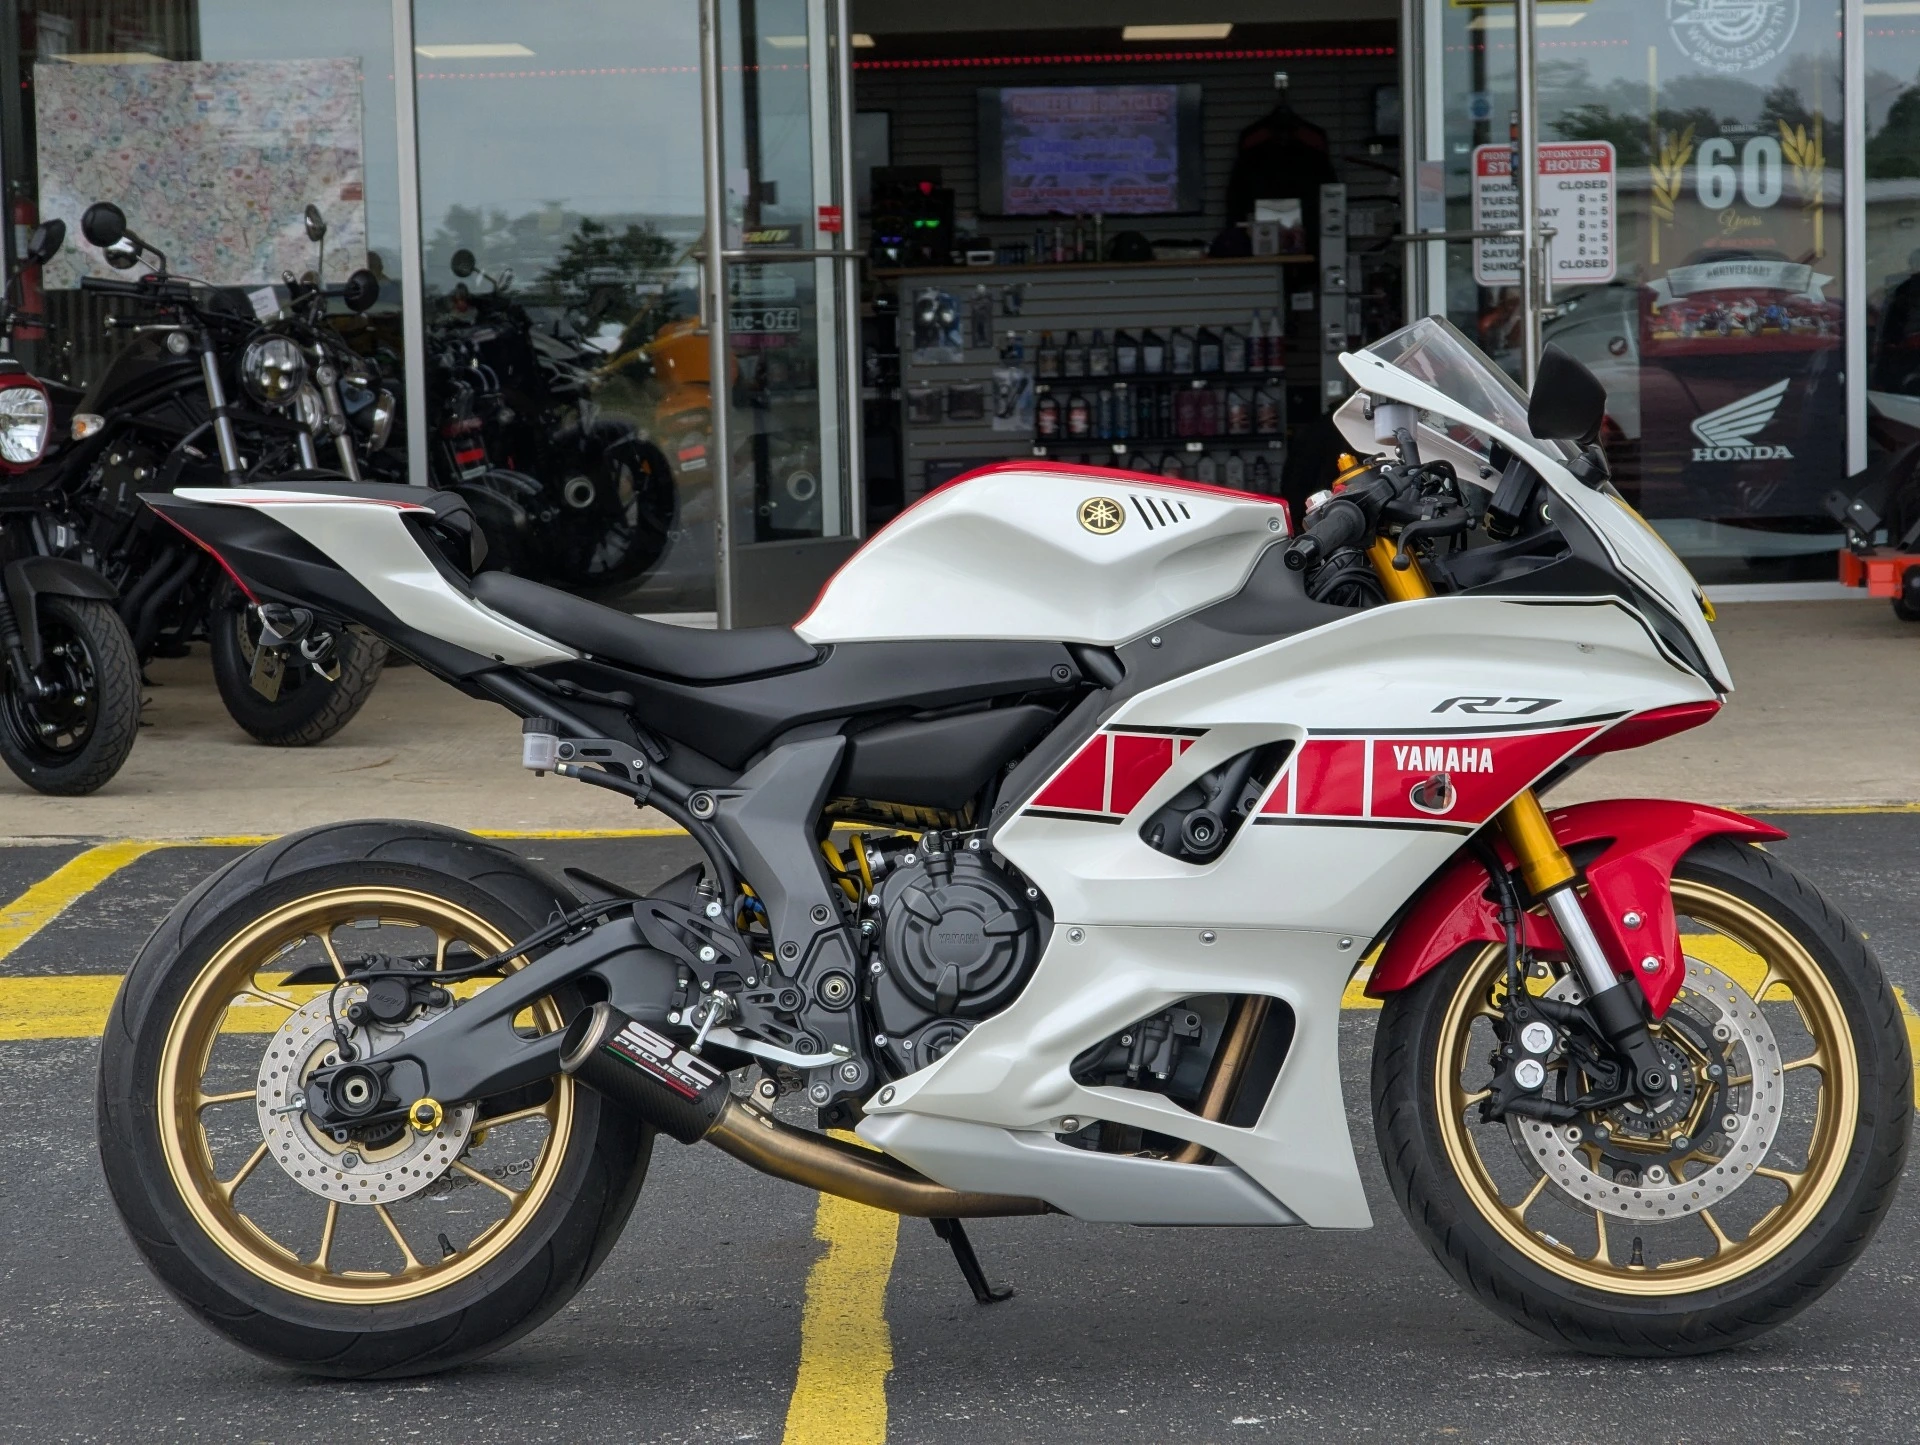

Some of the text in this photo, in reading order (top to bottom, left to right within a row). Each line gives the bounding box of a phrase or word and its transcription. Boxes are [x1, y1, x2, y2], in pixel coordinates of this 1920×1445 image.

[1538, 149, 1607, 159] OTORCYCLES
[1546, 159, 1601, 171] HOURS
[1696, 135, 1783, 210] 60
[1557, 180, 1608, 190] CLOSED
[1578, 194, 1586, 203] 8
[1601, 193, 1609, 202] 5
[1578, 207, 1586, 216] 8
[1601, 206, 1609, 215] 5
[1578, 220, 1586, 229] 8
[1601, 219, 1609, 228] 5
[1717, 208, 1763, 235] Years
[1578, 233, 1586, 242] 8
[1601, 232, 1609, 241] 5
[1578, 247, 1586, 256] 8
[1601, 246, 1609, 255] 3
[1559, 259, 1609, 269] CLOSED
[730, 310, 797, 330] uc-Off
[1692, 445, 1795, 462] HONDA
[1430, 696, 1563, 715] R7
[1392, 745, 1494, 774] YAMAHA
[619, 1021, 722, 1086] SC
[613, 1035, 708, 1090] PROJECT
